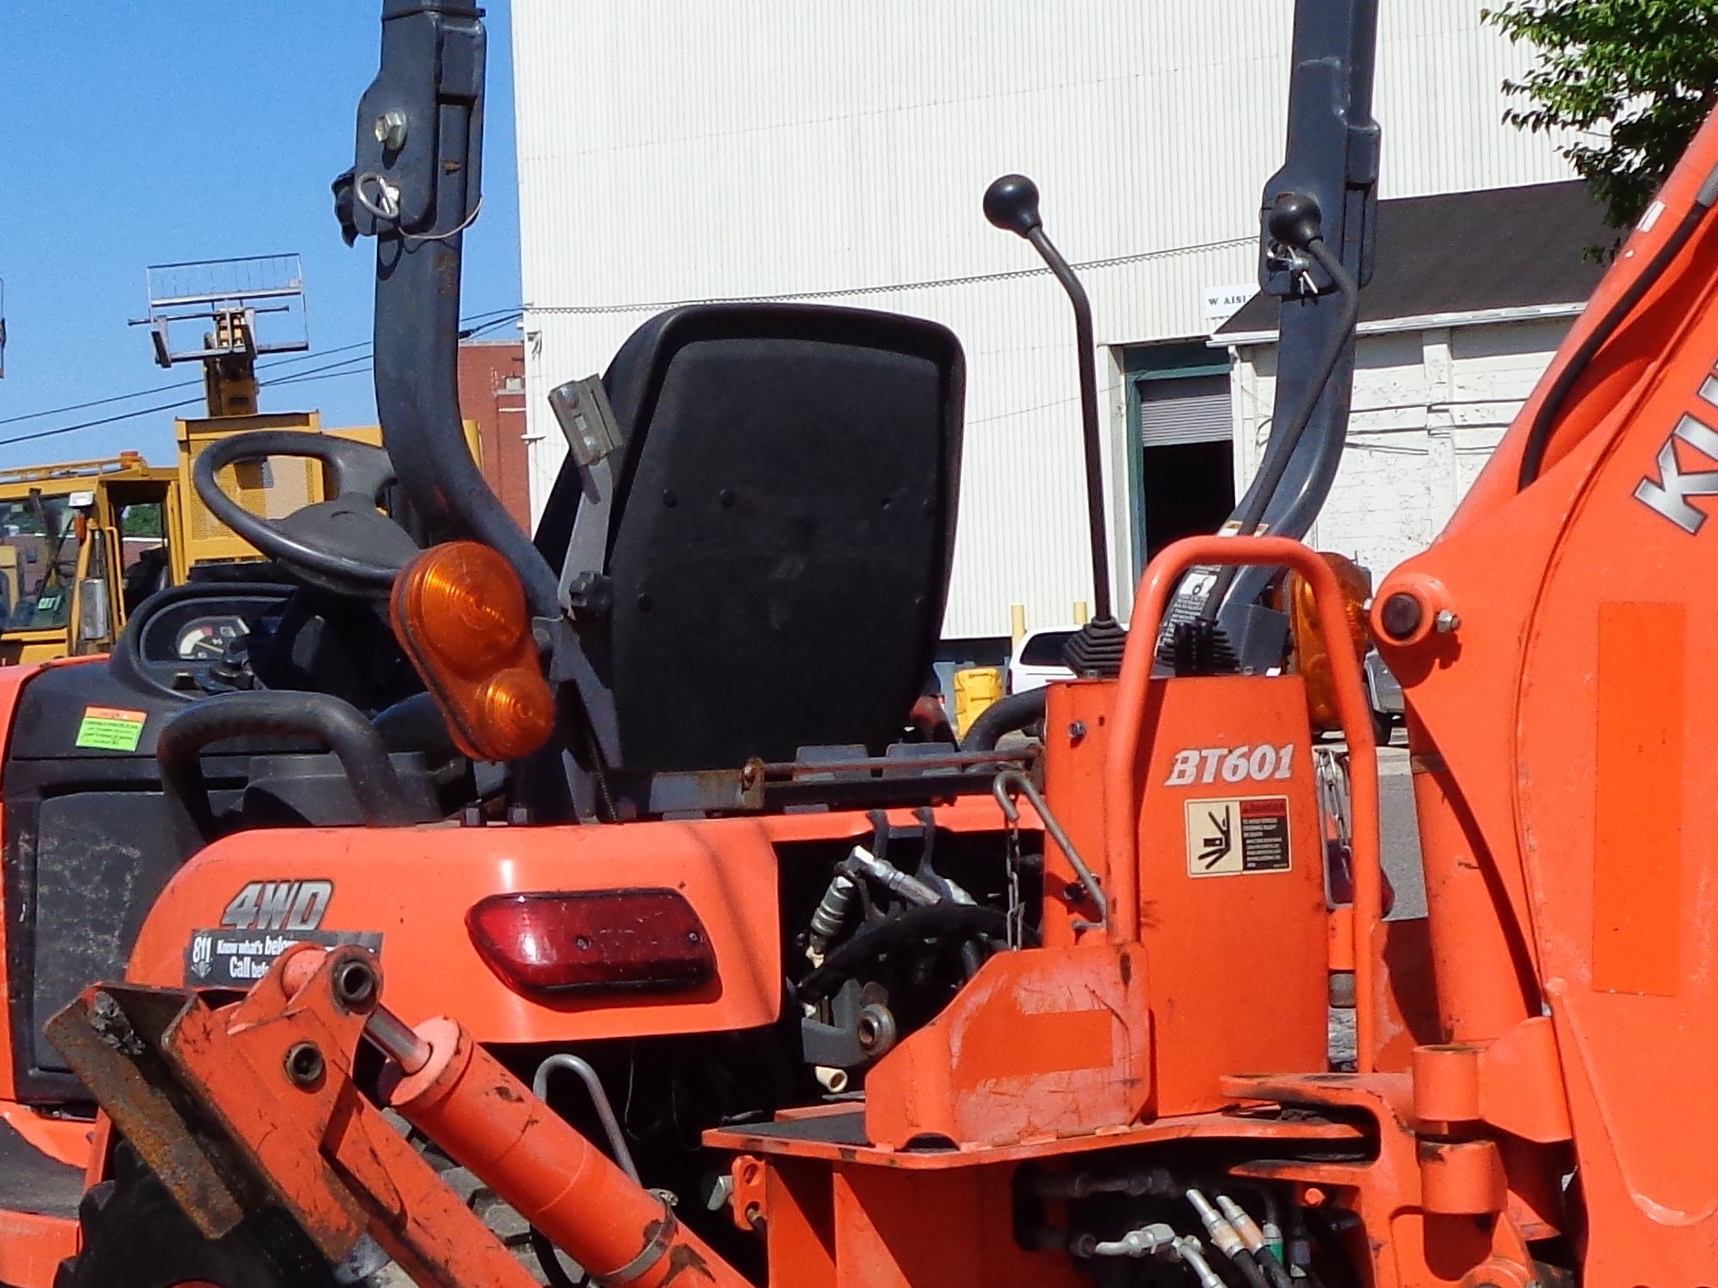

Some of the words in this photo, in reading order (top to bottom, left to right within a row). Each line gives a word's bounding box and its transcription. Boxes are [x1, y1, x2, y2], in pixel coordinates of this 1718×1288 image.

[1164, 743, 1294, 786] BT601
[219, 880, 334, 932] 4WD
[192, 936, 212, 964] 811
[216, 940, 238, 955] Know
[238, 939, 264, 955] what's
[229, 956, 251, 979] Call
